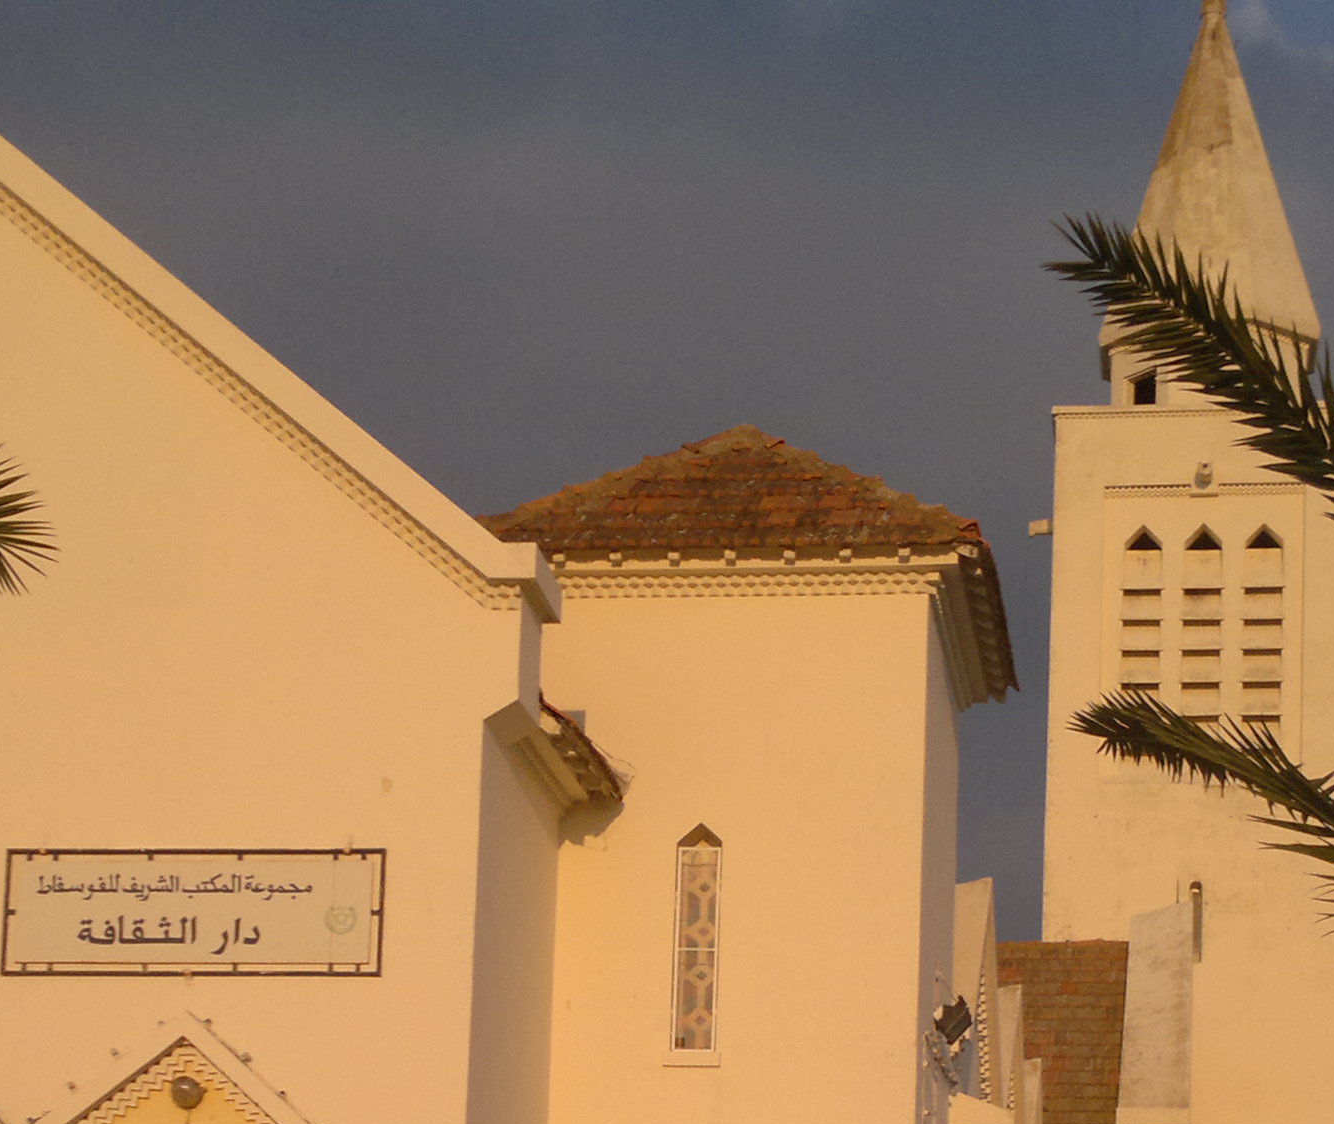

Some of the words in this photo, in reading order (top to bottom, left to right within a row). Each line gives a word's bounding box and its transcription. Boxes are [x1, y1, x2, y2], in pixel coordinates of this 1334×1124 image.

[36, 874, 120, 900] للفوسفاط
[122, 875, 179, 901] الشريف
[182, 874, 241, 899] المكتب
[244, 875, 313, 901] مجموعة
[77, 915, 197, 945] الثقافة
[210, 918, 261, 955] دار
